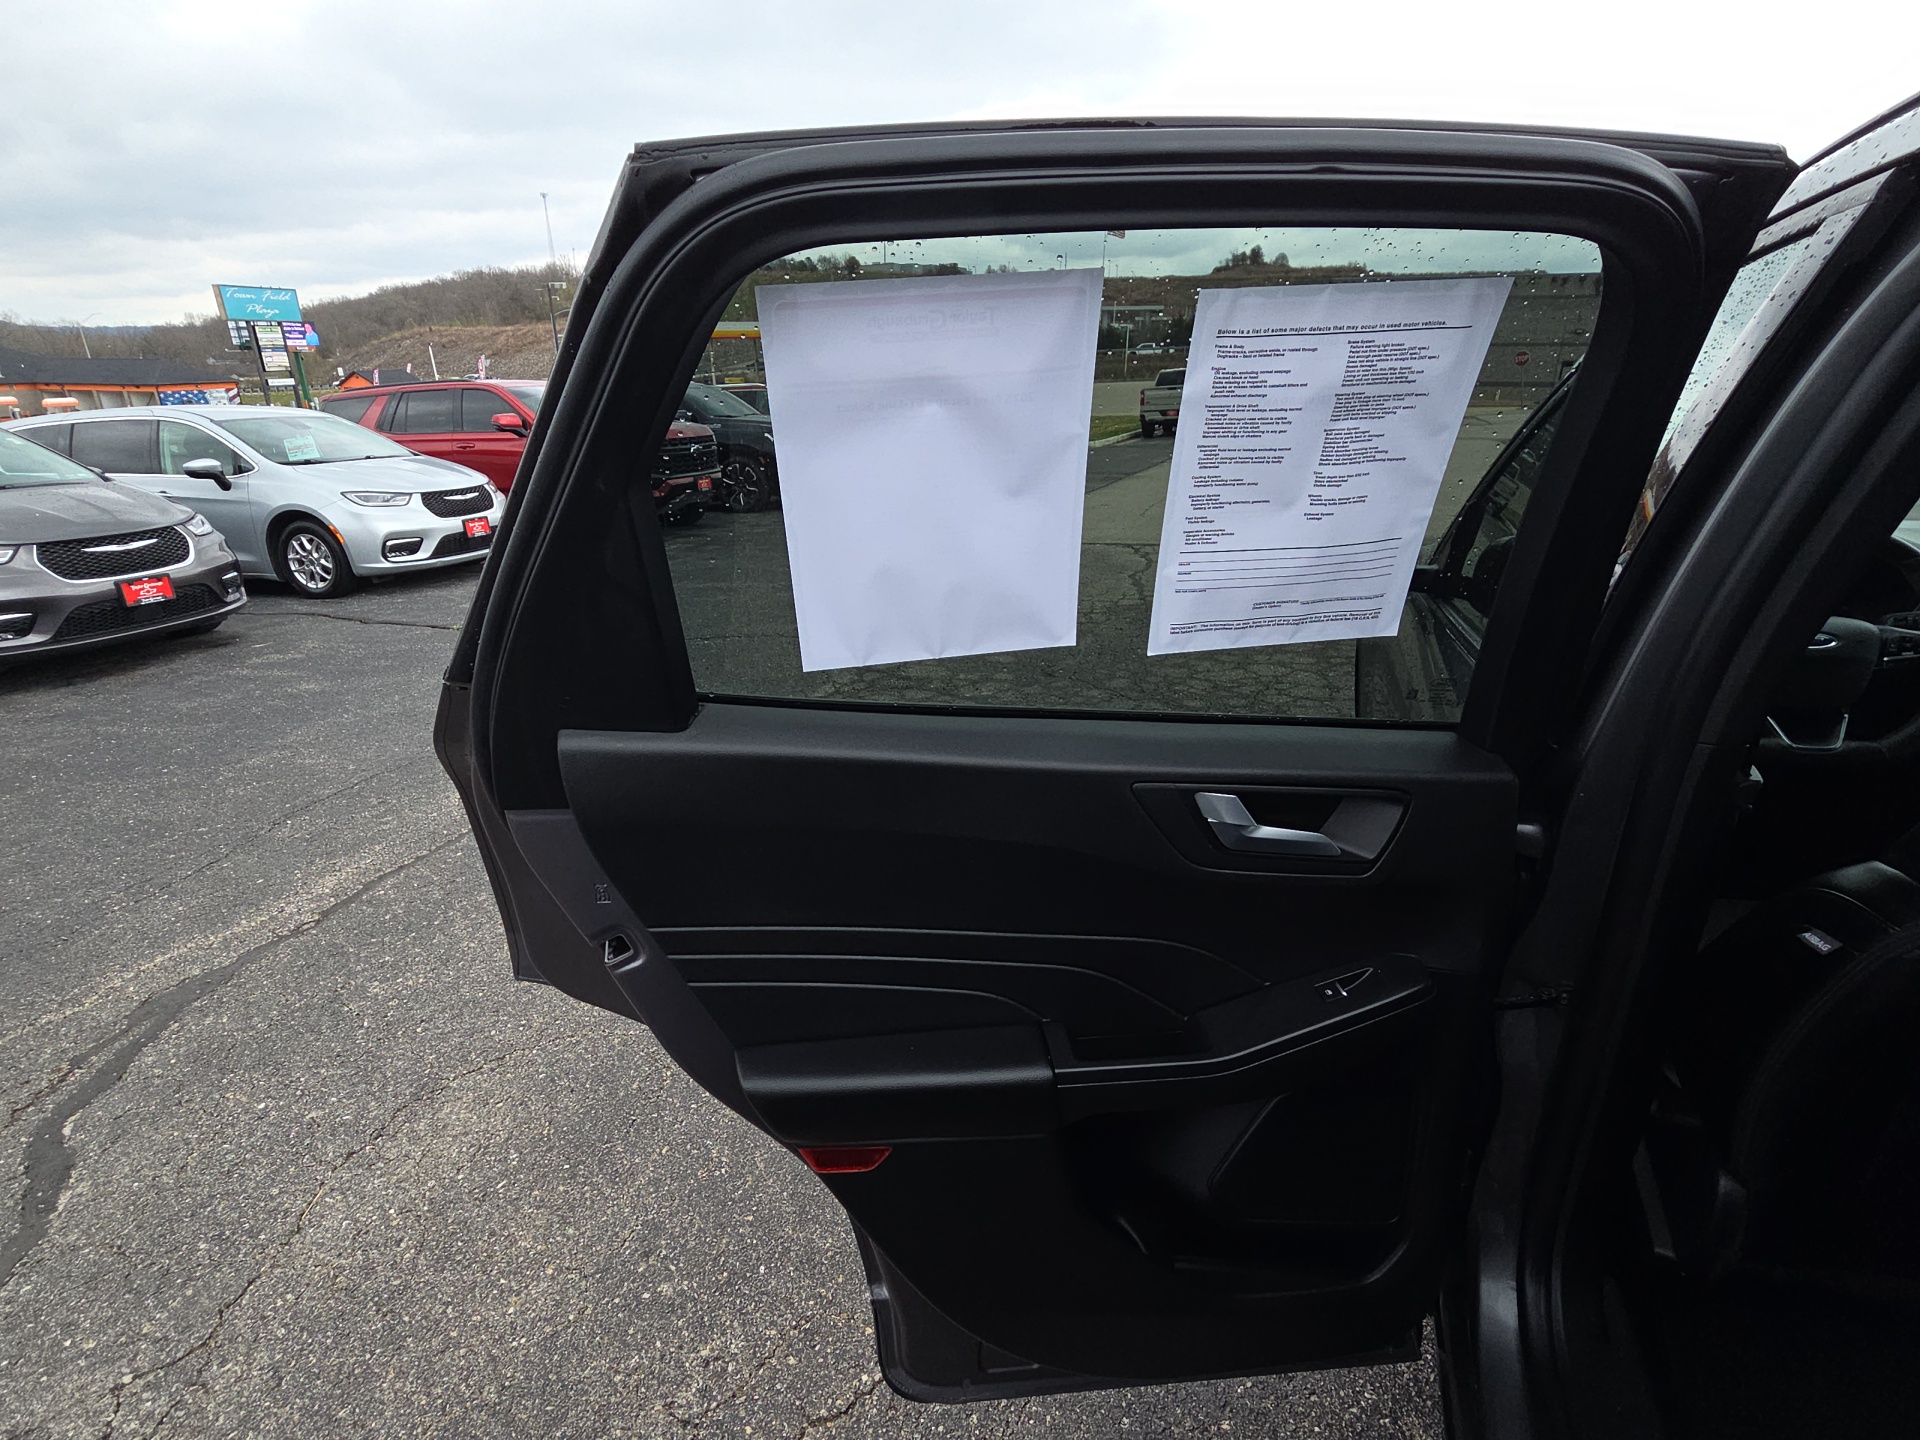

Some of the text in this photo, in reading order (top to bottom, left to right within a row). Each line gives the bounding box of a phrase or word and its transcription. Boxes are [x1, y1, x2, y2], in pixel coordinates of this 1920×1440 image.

[260, 290, 291, 302] Field
[246, 303, 280, 318] Plaza
[1801, 932, 1832, 951] AIRBAG
